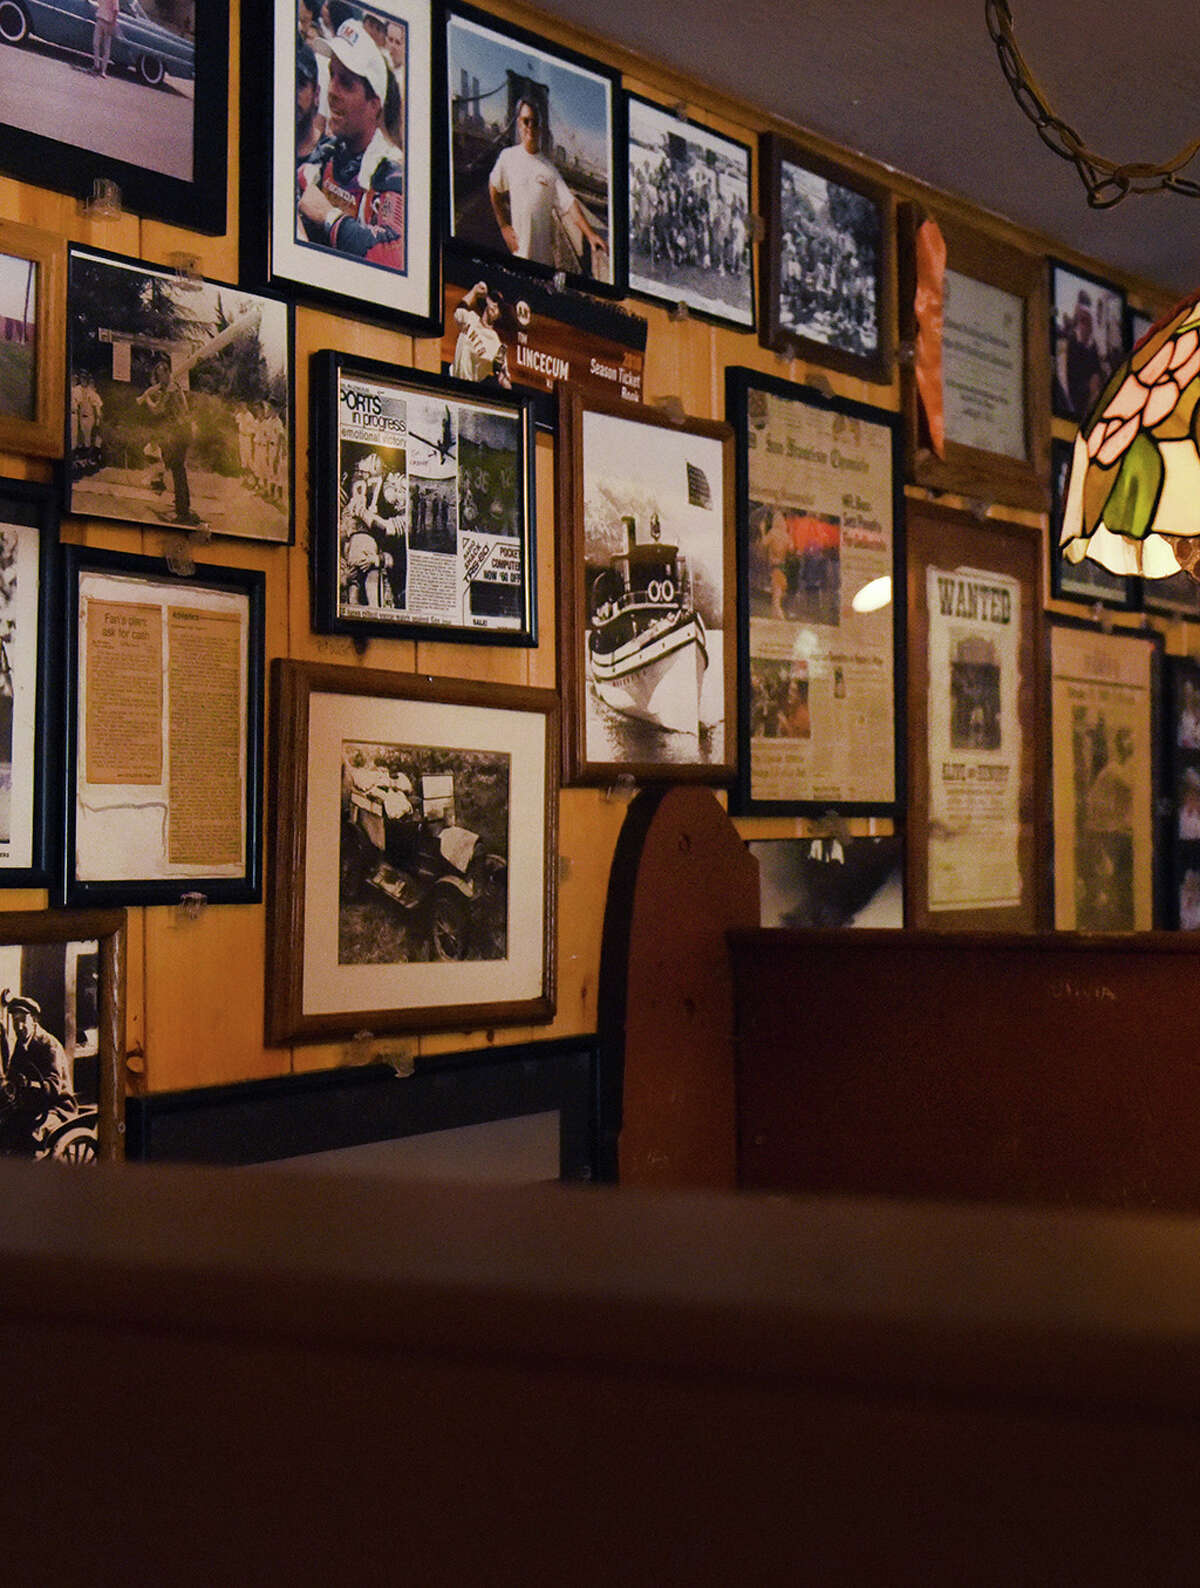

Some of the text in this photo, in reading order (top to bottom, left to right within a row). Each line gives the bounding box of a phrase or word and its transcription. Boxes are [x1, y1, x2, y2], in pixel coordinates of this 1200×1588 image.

[323, 178, 356, 206] HONDA
[516, 345, 570, 381] LINCECUM
[590, 358, 617, 381] Season
[618, 367, 641, 388] Ticket
[363, 413, 407, 432] progress
[937, 576, 1011, 625] WANTED
